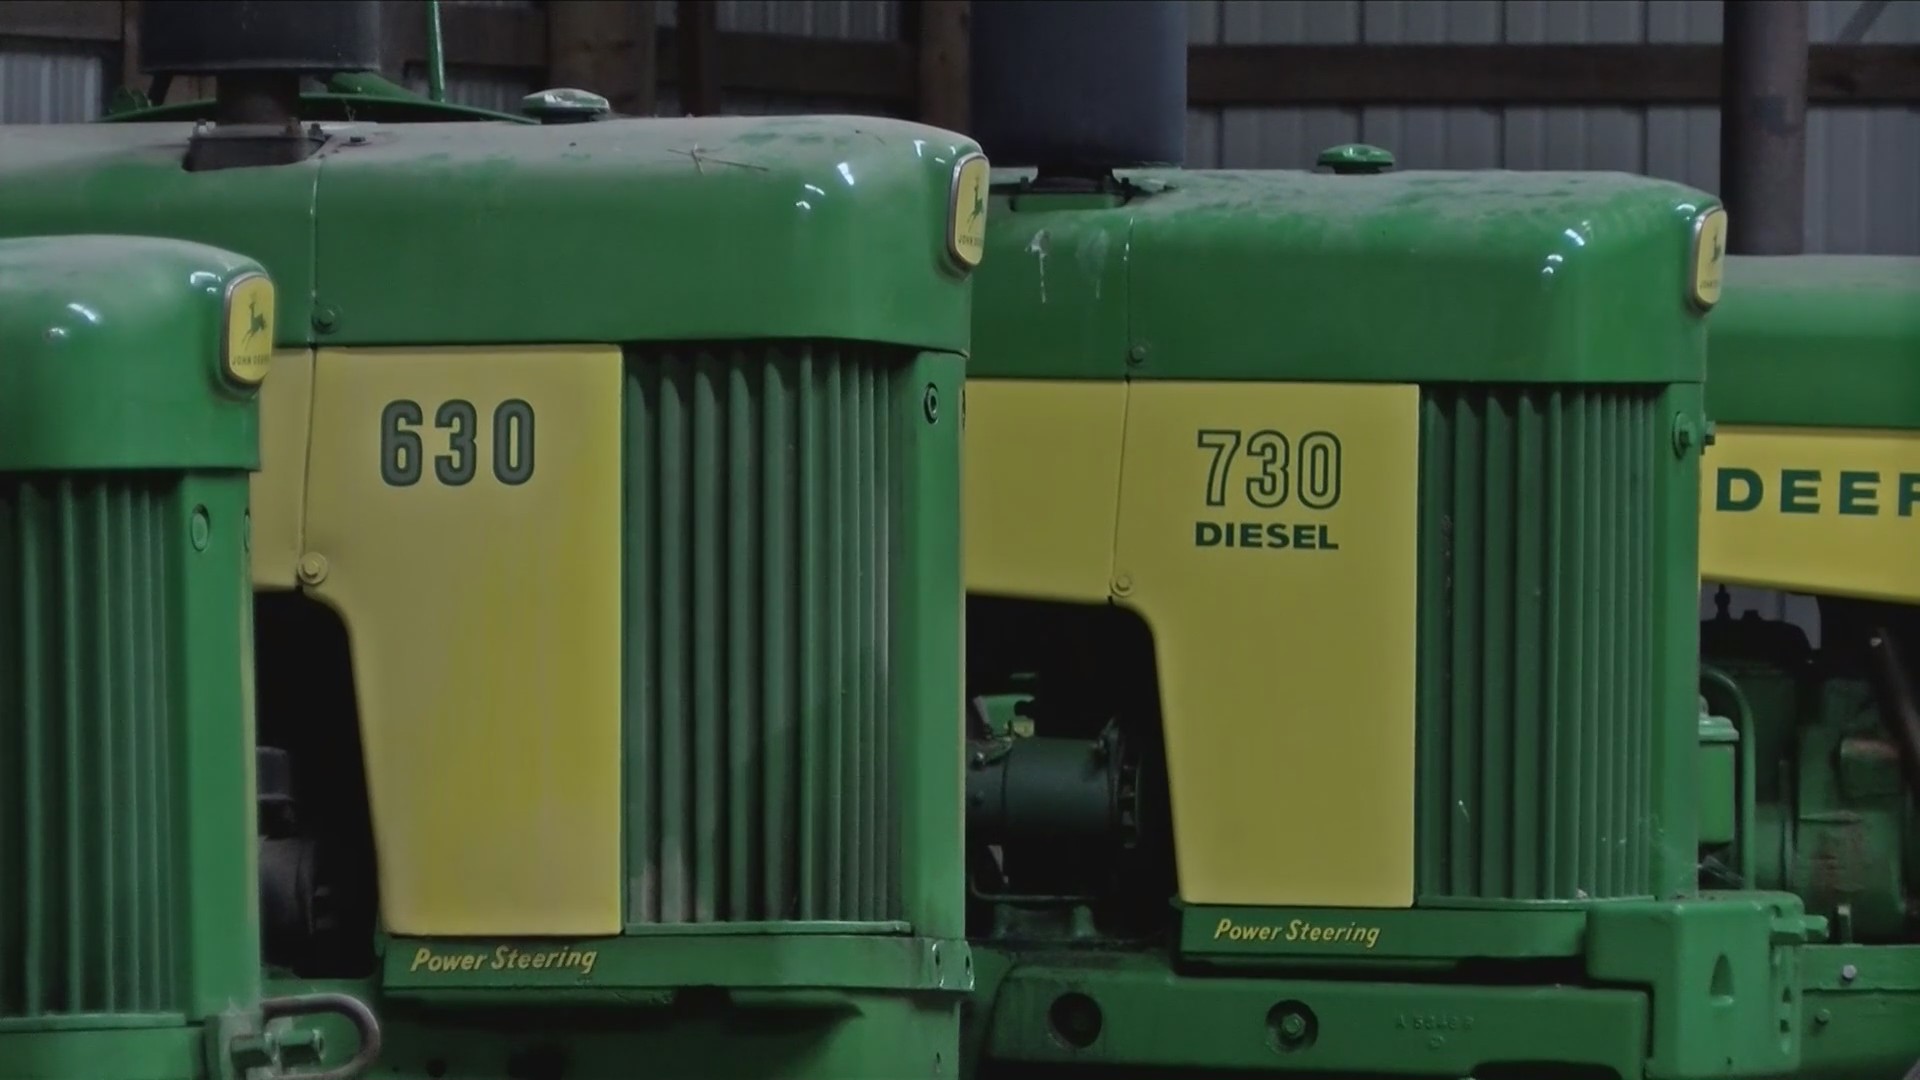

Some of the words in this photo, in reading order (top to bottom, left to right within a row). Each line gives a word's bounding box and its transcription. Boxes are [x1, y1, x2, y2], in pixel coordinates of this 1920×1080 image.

[380, 398, 535, 487] 630
[1197, 429, 1341, 510] 730
[1195, 522, 1339, 550] DIESEL
[1214, 918, 1282, 940] Power
[1286, 919, 1380, 948] Steering
[410, 948, 487, 972] Power
[491, 945, 597, 974] Steering
